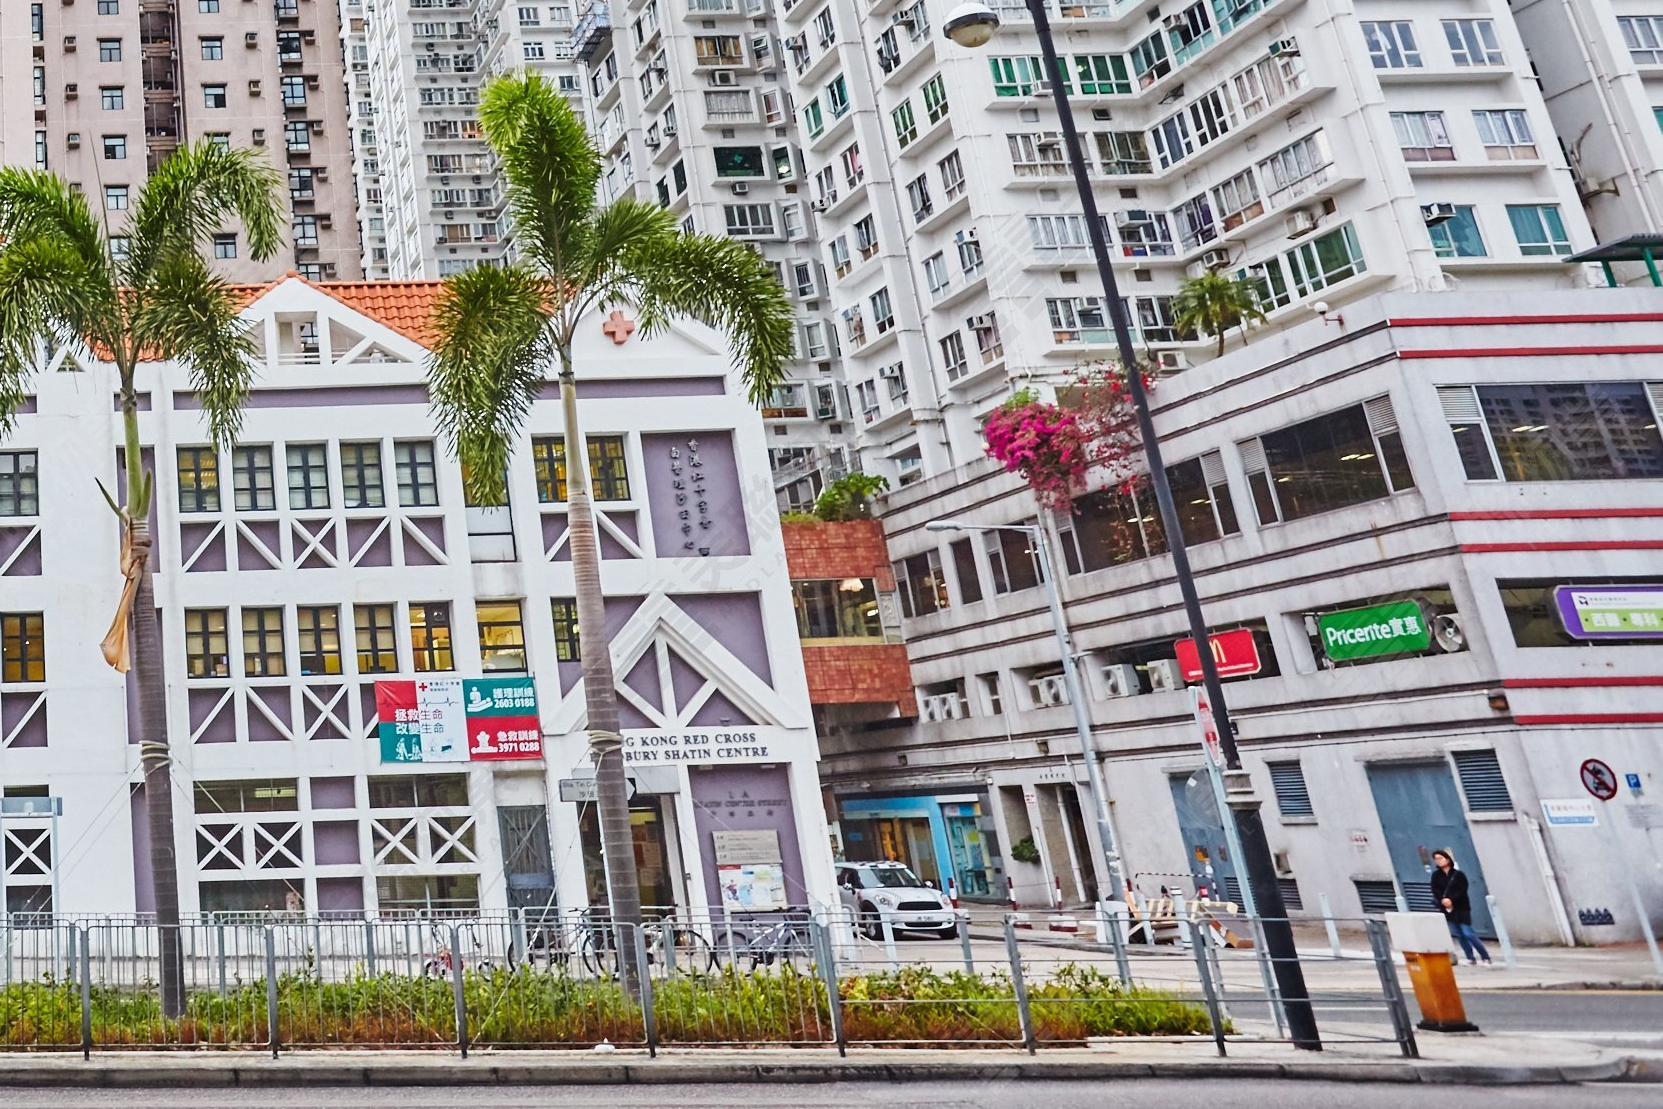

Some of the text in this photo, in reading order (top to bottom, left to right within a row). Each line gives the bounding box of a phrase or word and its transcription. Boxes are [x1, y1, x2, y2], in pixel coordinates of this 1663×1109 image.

[1325, 623, 1391, 647] Pricerite
[494, 697, 535, 709] 2603 0188
[395, 708, 443, 722] 拯救生命
[395, 722, 445, 735] 改變生命
[641, 735, 678, 747] KONG
[684, 734, 709, 745] RED
[715, 732, 756, 744] CROSS
[499, 741, 540, 753] 3971 0288
[664, 749, 711, 760] SHATIN
[717, 747, 769, 758] CENTRE
